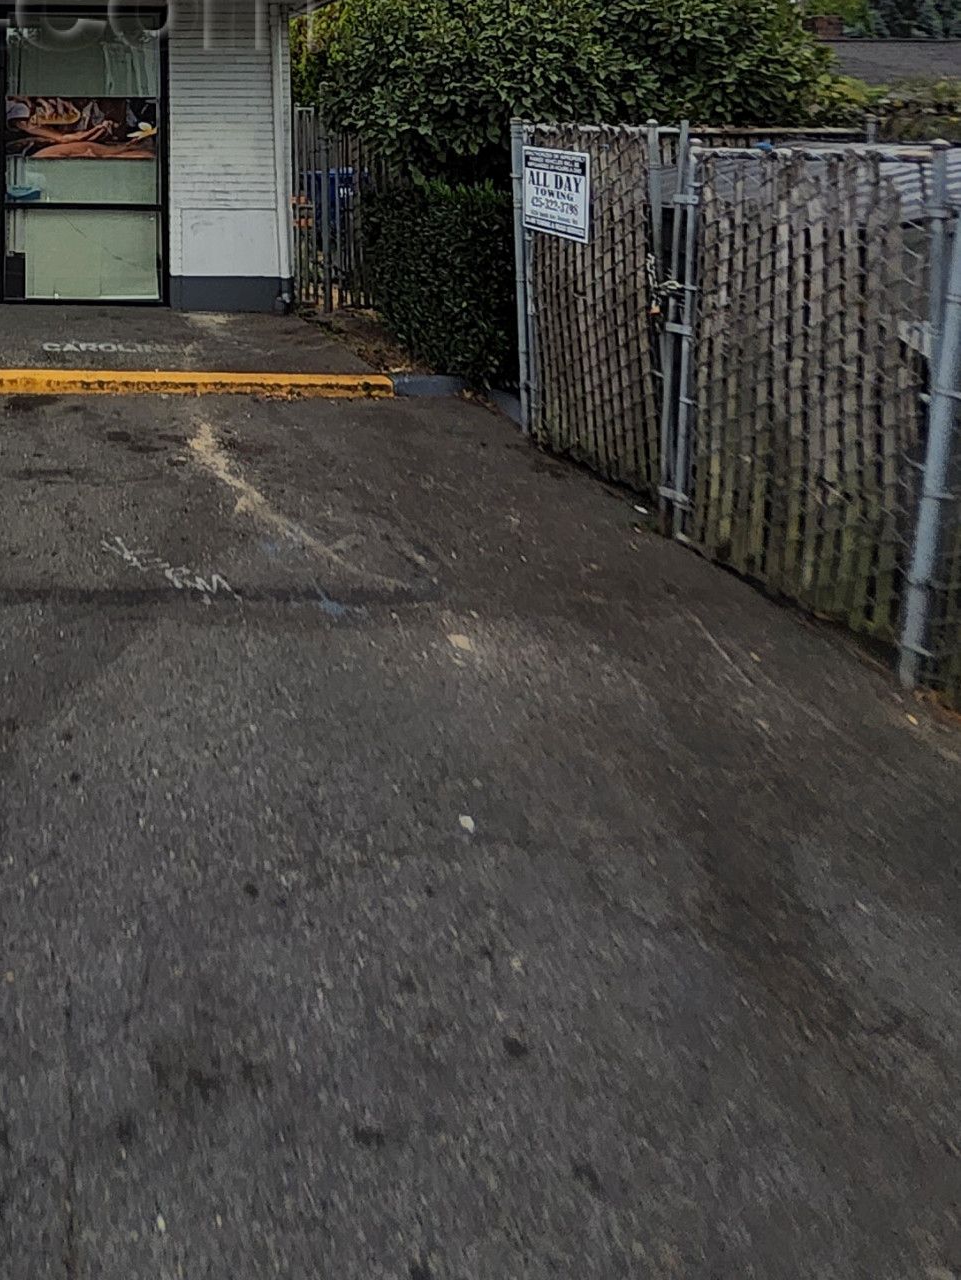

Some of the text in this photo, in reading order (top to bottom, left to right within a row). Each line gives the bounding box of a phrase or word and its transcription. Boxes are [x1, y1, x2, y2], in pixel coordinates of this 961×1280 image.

[528, 170, 582, 193] ALL DAY
[534, 187, 574, 201] TOWING
